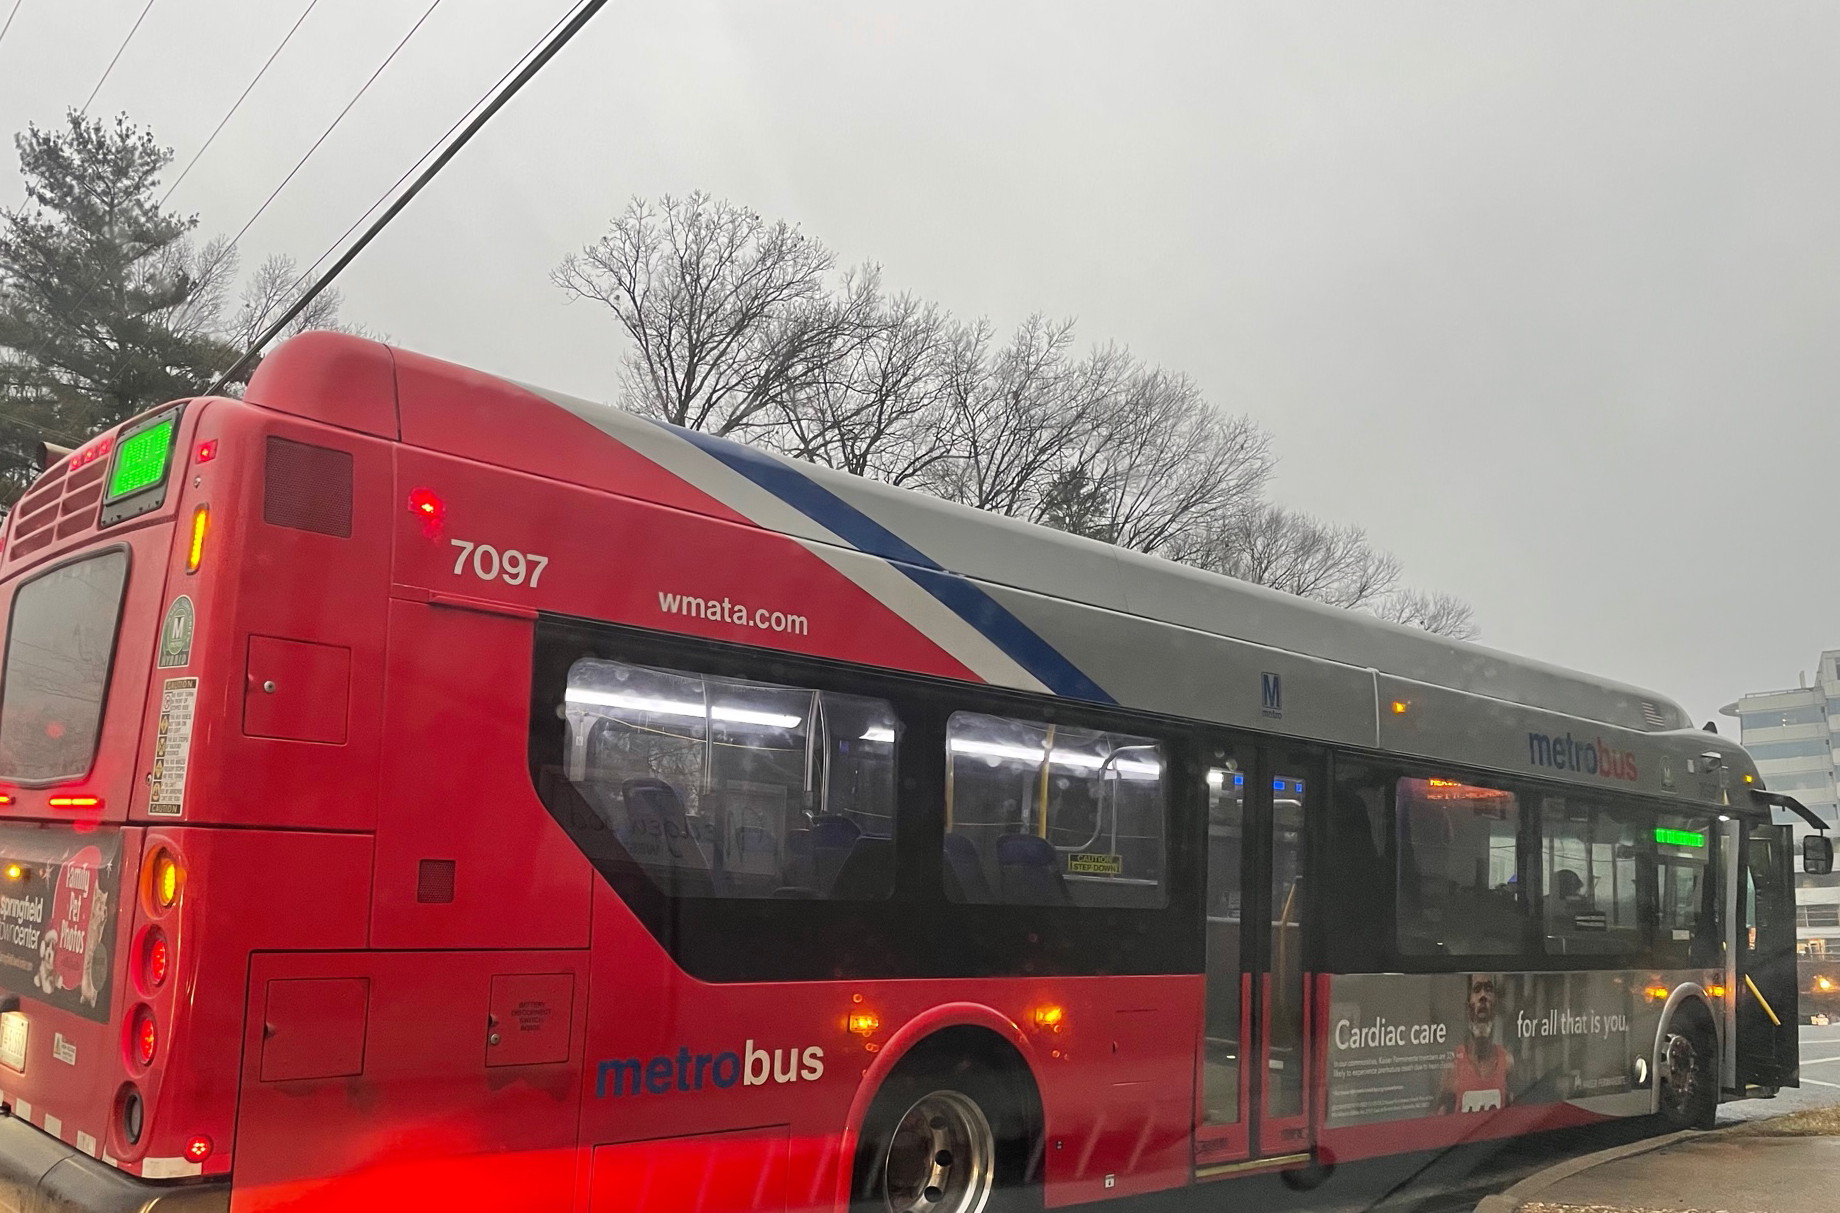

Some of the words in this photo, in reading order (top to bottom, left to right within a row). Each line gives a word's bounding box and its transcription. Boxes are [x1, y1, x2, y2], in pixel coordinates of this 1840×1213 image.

[450, 539, 548, 588] 7097
[658, 590, 808, 635] wmata.com
[1263, 674, 1280, 708] M
[1262, 710, 1282, 720] metro
[1529, 732, 1638, 781] metrobus
[151, 804, 178, 813] CAUTION
[66, 861, 90, 898] Family
[1073, 863, 1091, 871] STEP
[0, 895, 44, 924] springfield
[69, 891, 82, 922] Pet
[0, 921, 40, 950] owncenter
[60, 919, 85, 954] Photos
[1335, 1016, 1406, 1050] Cardiac
[1410, 1022, 1447, 1045] care
[1517, 1010, 1539, 1038] for
[1541, 1009, 1557, 1036] all
[1560, 1008, 1588, 1035] that
[1591, 1009, 1600, 1033] is
[1603, 1014, 1629, 1040] you.
[595, 1038, 824, 1099] metrobus
